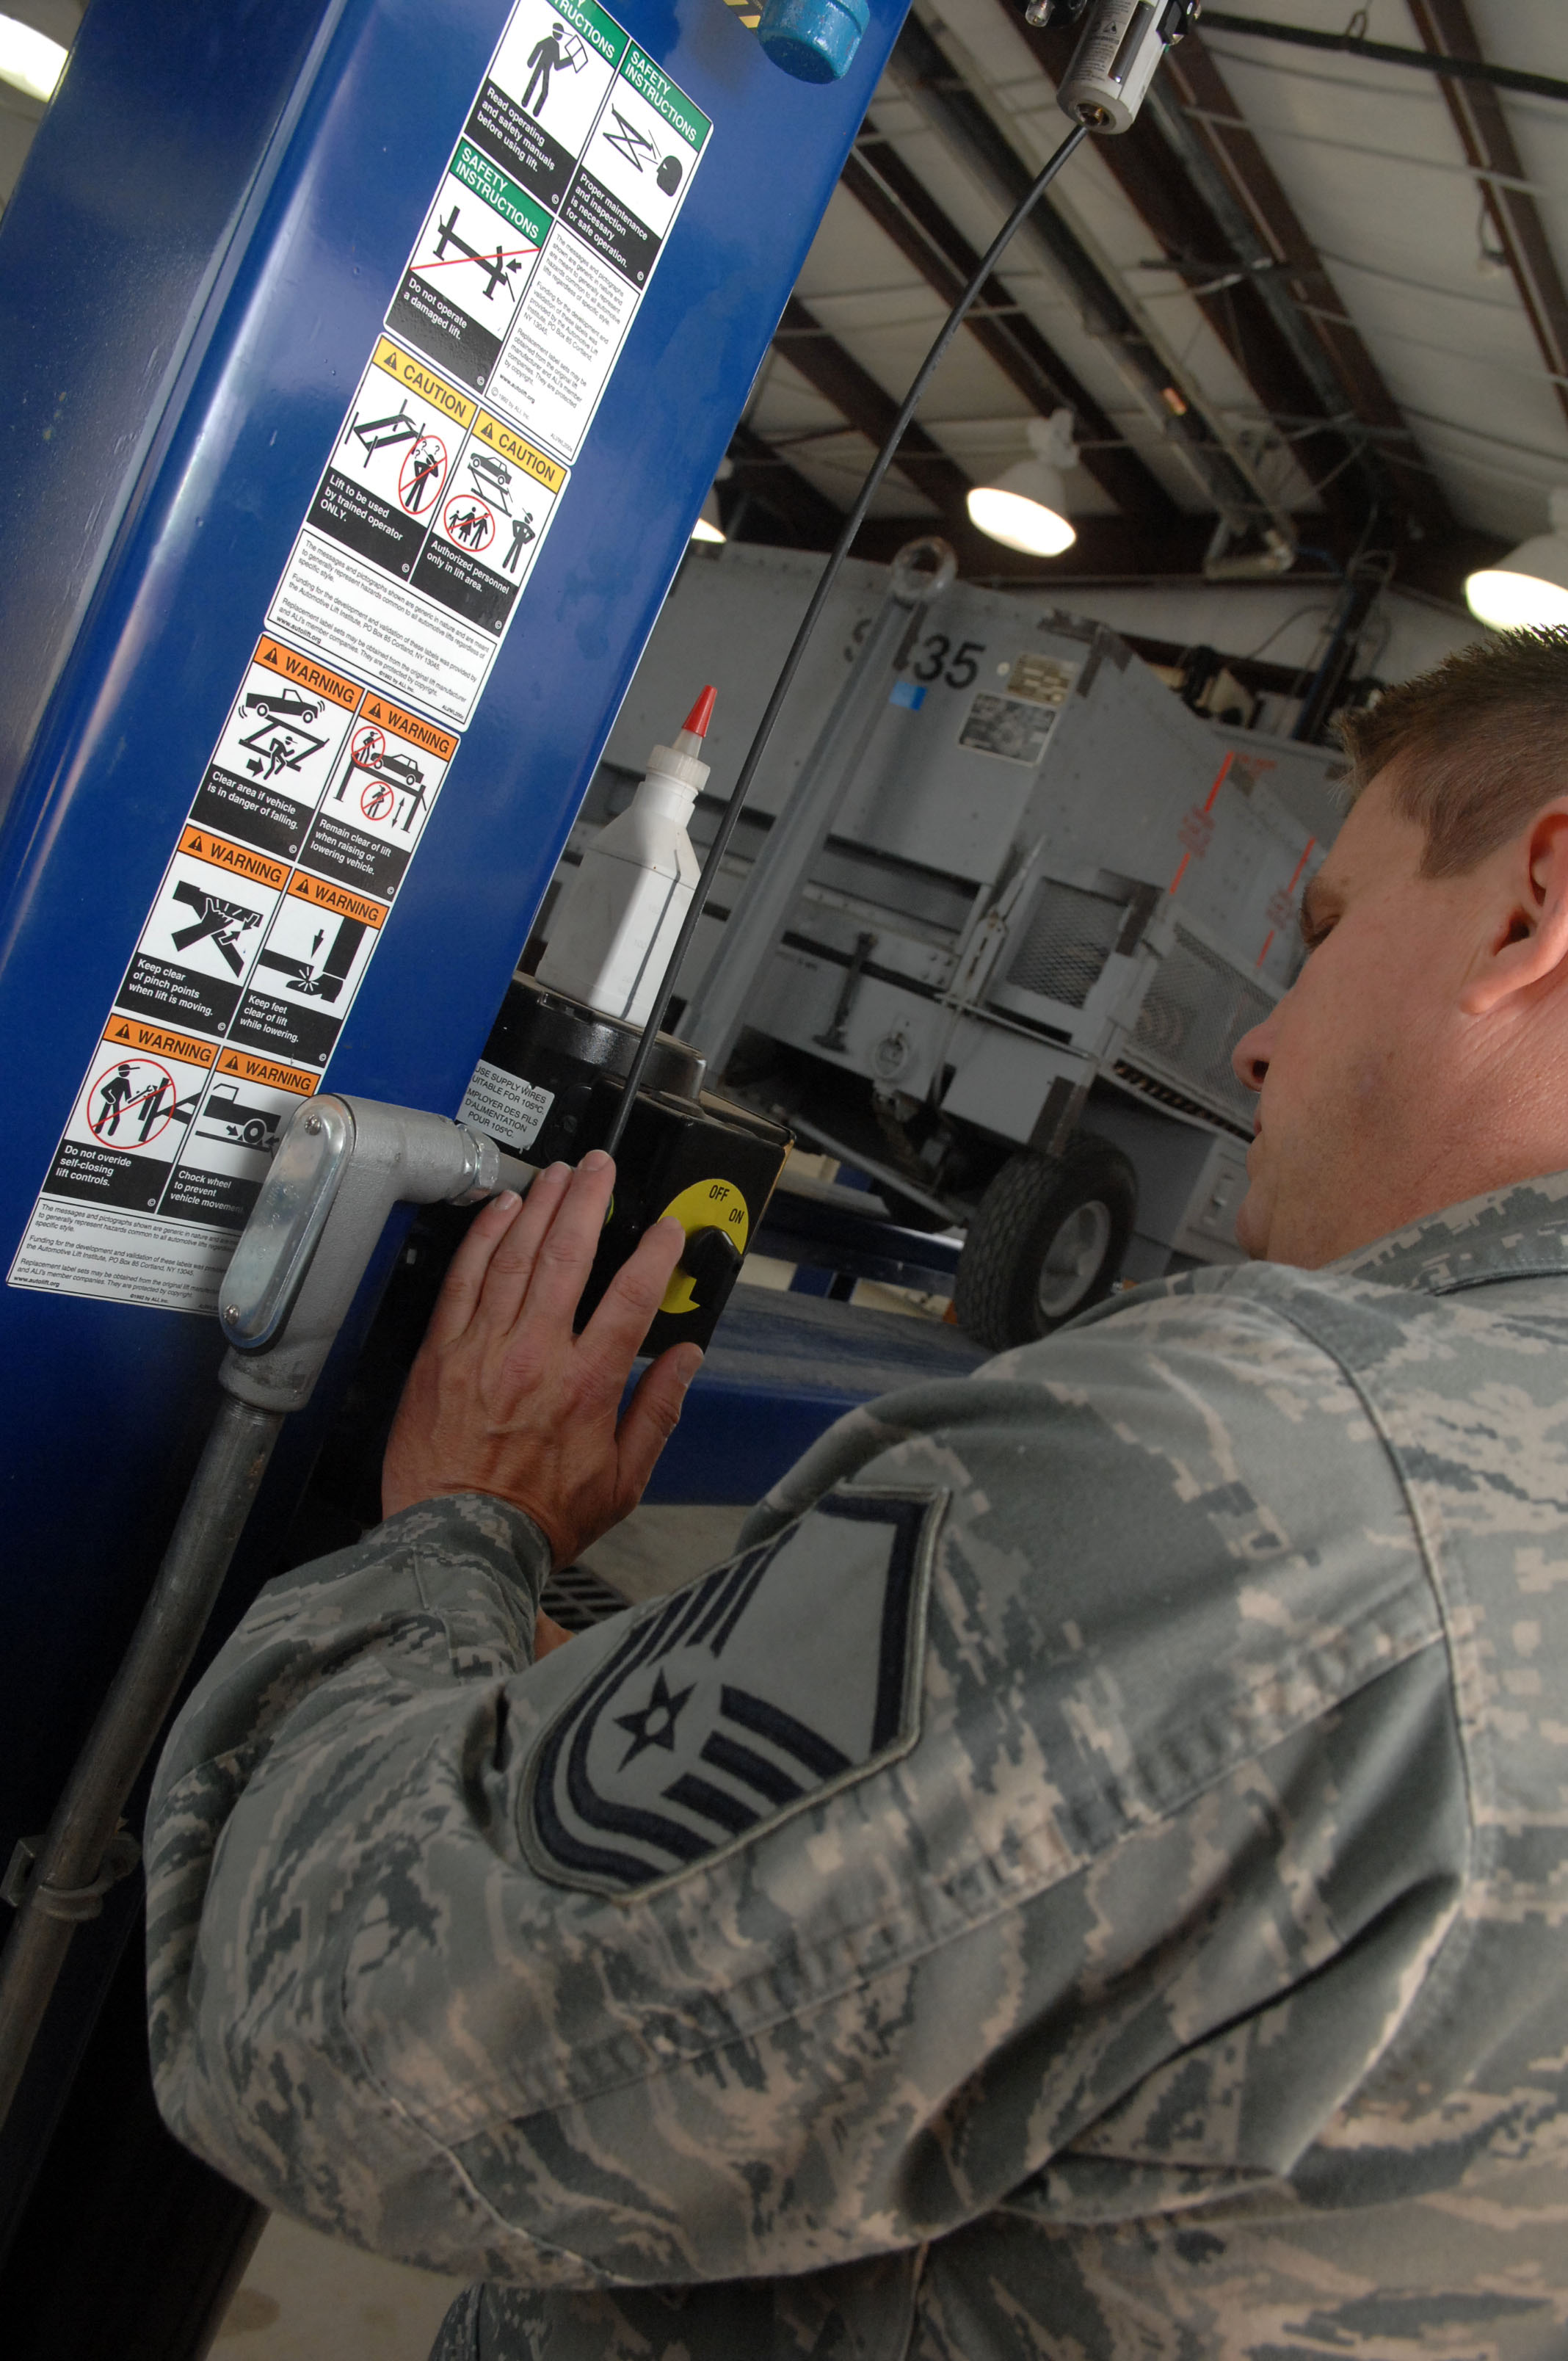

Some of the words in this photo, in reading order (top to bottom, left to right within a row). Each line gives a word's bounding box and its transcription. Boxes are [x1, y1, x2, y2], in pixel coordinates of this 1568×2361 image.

[559, 0, 614, 58] RUCTIONS
[631, 51, 670, 95] SAFETY
[487, 87, 509, 111] Read
[508, 109, 545, 147] operating
[625, 63, 696, 141] INSTRUCTIONS
[476, 110, 502, 139] before
[503, 136, 526, 161] using
[526, 154, 537, 172] lift.
[482, 101, 498, 118] and
[498, 115, 522, 141] safety
[522, 137, 554, 170] manuals
[462, 147, 508, 192] SAFETY
[456, 160, 538, 238] INSTRUCTIONS
[570, 195, 578, 207] is
[578, 204, 614, 241] necessary
[575, 186, 590, 202] and
[589, 197, 625, 236] inspection
[580, 173, 605, 200] Proper
[604, 197, 647, 240] maintenance
[566, 207, 578, 221] for
[577, 219, 593, 236] safe
[593, 233, 627, 267] operation.
[556, 233, 566, 246] The
[565, 244, 589, 267] messages
[589, 264, 600, 275] and
[598, 272, 624, 297] pictographs
[408, 278, 421, 292] Do
[421, 289, 436, 305] not
[437, 302, 467, 328] operate
[545, 257, 565, 278] hazards
[565, 275, 586, 294] common
[585, 291, 591, 299] to
[596, 302, 621, 324] automotive
[403, 291, 410, 300] a
[410, 297, 449, 329] damaged
[448, 324, 460, 339] lift.
[403, 364, 466, 417] CAUTION
[499, 374, 535, 405] www.autolift.org
[498, 433, 555, 482] CAUTION
[320, 498, 346, 521] ONLY.
[324, 486, 336, 501] by
[337, 494, 368, 518] trained
[368, 515, 403, 540] operator
[329, 474, 344, 490] Lift
[345, 485, 355, 496] to
[355, 490, 367, 504] be
[368, 500, 389, 518] used
[427, 552, 444, 568] only
[444, 562, 453, 573] in
[453, 567, 464, 580] lift
[464, 576, 482, 592] area.
[431, 540, 473, 571] Authorized
[471, 567, 509, 594] personnel
[277, 616, 322, 645] www.autolift.org
[288, 581, 299, 592] the
[298, 587, 330, 609] Automotive
[330, 604, 340, 614] Lift
[363, 622, 373, 632] PO
[372, 628, 383, 639] Box
[383, 634, 391, 643] 85
[415, 651, 424, 660] NY
[291, 573, 316, 592] Funding
[315, 586, 324, 595] for
[324, 591, 333, 601] the
[333, 598, 369, 620] development
[368, 617, 380, 627] and
[379, 623, 404, 641] validation
[410, 639, 424, 652] these
[424, 648, 439, 661] labels
[439, 658, 450, 667] was
[449, 664, 471, 679] provided
[470, 675, 477, 683] by
[286, 656, 354, 703] WARNING
[914, 634, 986, 689] 35
[388, 710, 449, 753] WARNING
[207, 782, 216, 793] is
[217, 786, 226, 797] in
[228, 792, 259, 810] danger
[260, 807, 270, 816] of
[270, 810, 297, 830] falling.
[212, 771, 236, 787] Clear
[236, 783, 256, 797] area
[257, 791, 266, 800] if
[266, 796, 295, 814] vehicle
[310, 840, 345, 863] lowering
[346, 857, 374, 874] vehicle.
[315, 831, 337, 845] when
[338, 841, 365, 859] raising
[319, 819, 349, 838] Remain
[350, 834, 371, 846] clear
[380, 846, 391, 857] lift
[211, 842, 281, 882] WARNING
[315, 885, 378, 921] WARNING
[133, 971, 144, 980] of
[143, 975, 170, 989] pinch
[170, 984, 200, 998] points
[137, 958, 161, 974] Keep
[162, 968, 186, 981] clear
[128, 983, 153, 996] when
[154, 990, 167, 1001] lift
[168, 994, 177, 1004] is
[178, 999, 212, 1016] moving.
[244, 1007, 265, 1018] clear
[266, 1014, 276, 1022] of
[275, 1015, 287, 1026] lift
[248, 995, 269, 1009] Keep
[271, 1002, 287, 1014] feet
[138, 1029, 211, 1062] WARNING
[240, 1018, 261, 1029] while
[262, 1023, 298, 1042] lowering.
[246, 1060, 311, 1090] WARNING
[472, 1075, 503, 1095] UITABLE
[503, 1089, 520, 1103] FOR
[490, 1073, 520, 1091] SUPPLY
[520, 1087, 546, 1103] WIRES
[465, 1098, 527, 1132] D'ALIMENTATION
[466, 1087, 503, 1110] MPLOYER
[503, 1105, 520, 1117] DES
[520, 1113, 538, 1125] FILS
[468, 1111, 490, 1126] POUR
[59, 1158, 114, 1176] self-closing
[64, 1145, 78, 1155] Do
[79, 1150, 96, 1158] not
[97, 1153, 131, 1167] overide
[55, 1167, 68, 1177] lift
[70, 1172, 109, 1186] controls.
[174, 1180, 183, 1189] to
[184, 1184, 217, 1197] prevent
[178, 1170, 206, 1183] Chock
[207, 1178, 231, 1188] wheel
[709, 1185, 730, 1201] OFF
[170, 1193, 200, 1204] vehicle
[729, 1208, 744, 1224] ON
[35, 1220, 59, 1229] specific
[13, 1276, 60, 1288] www.autolift.org
